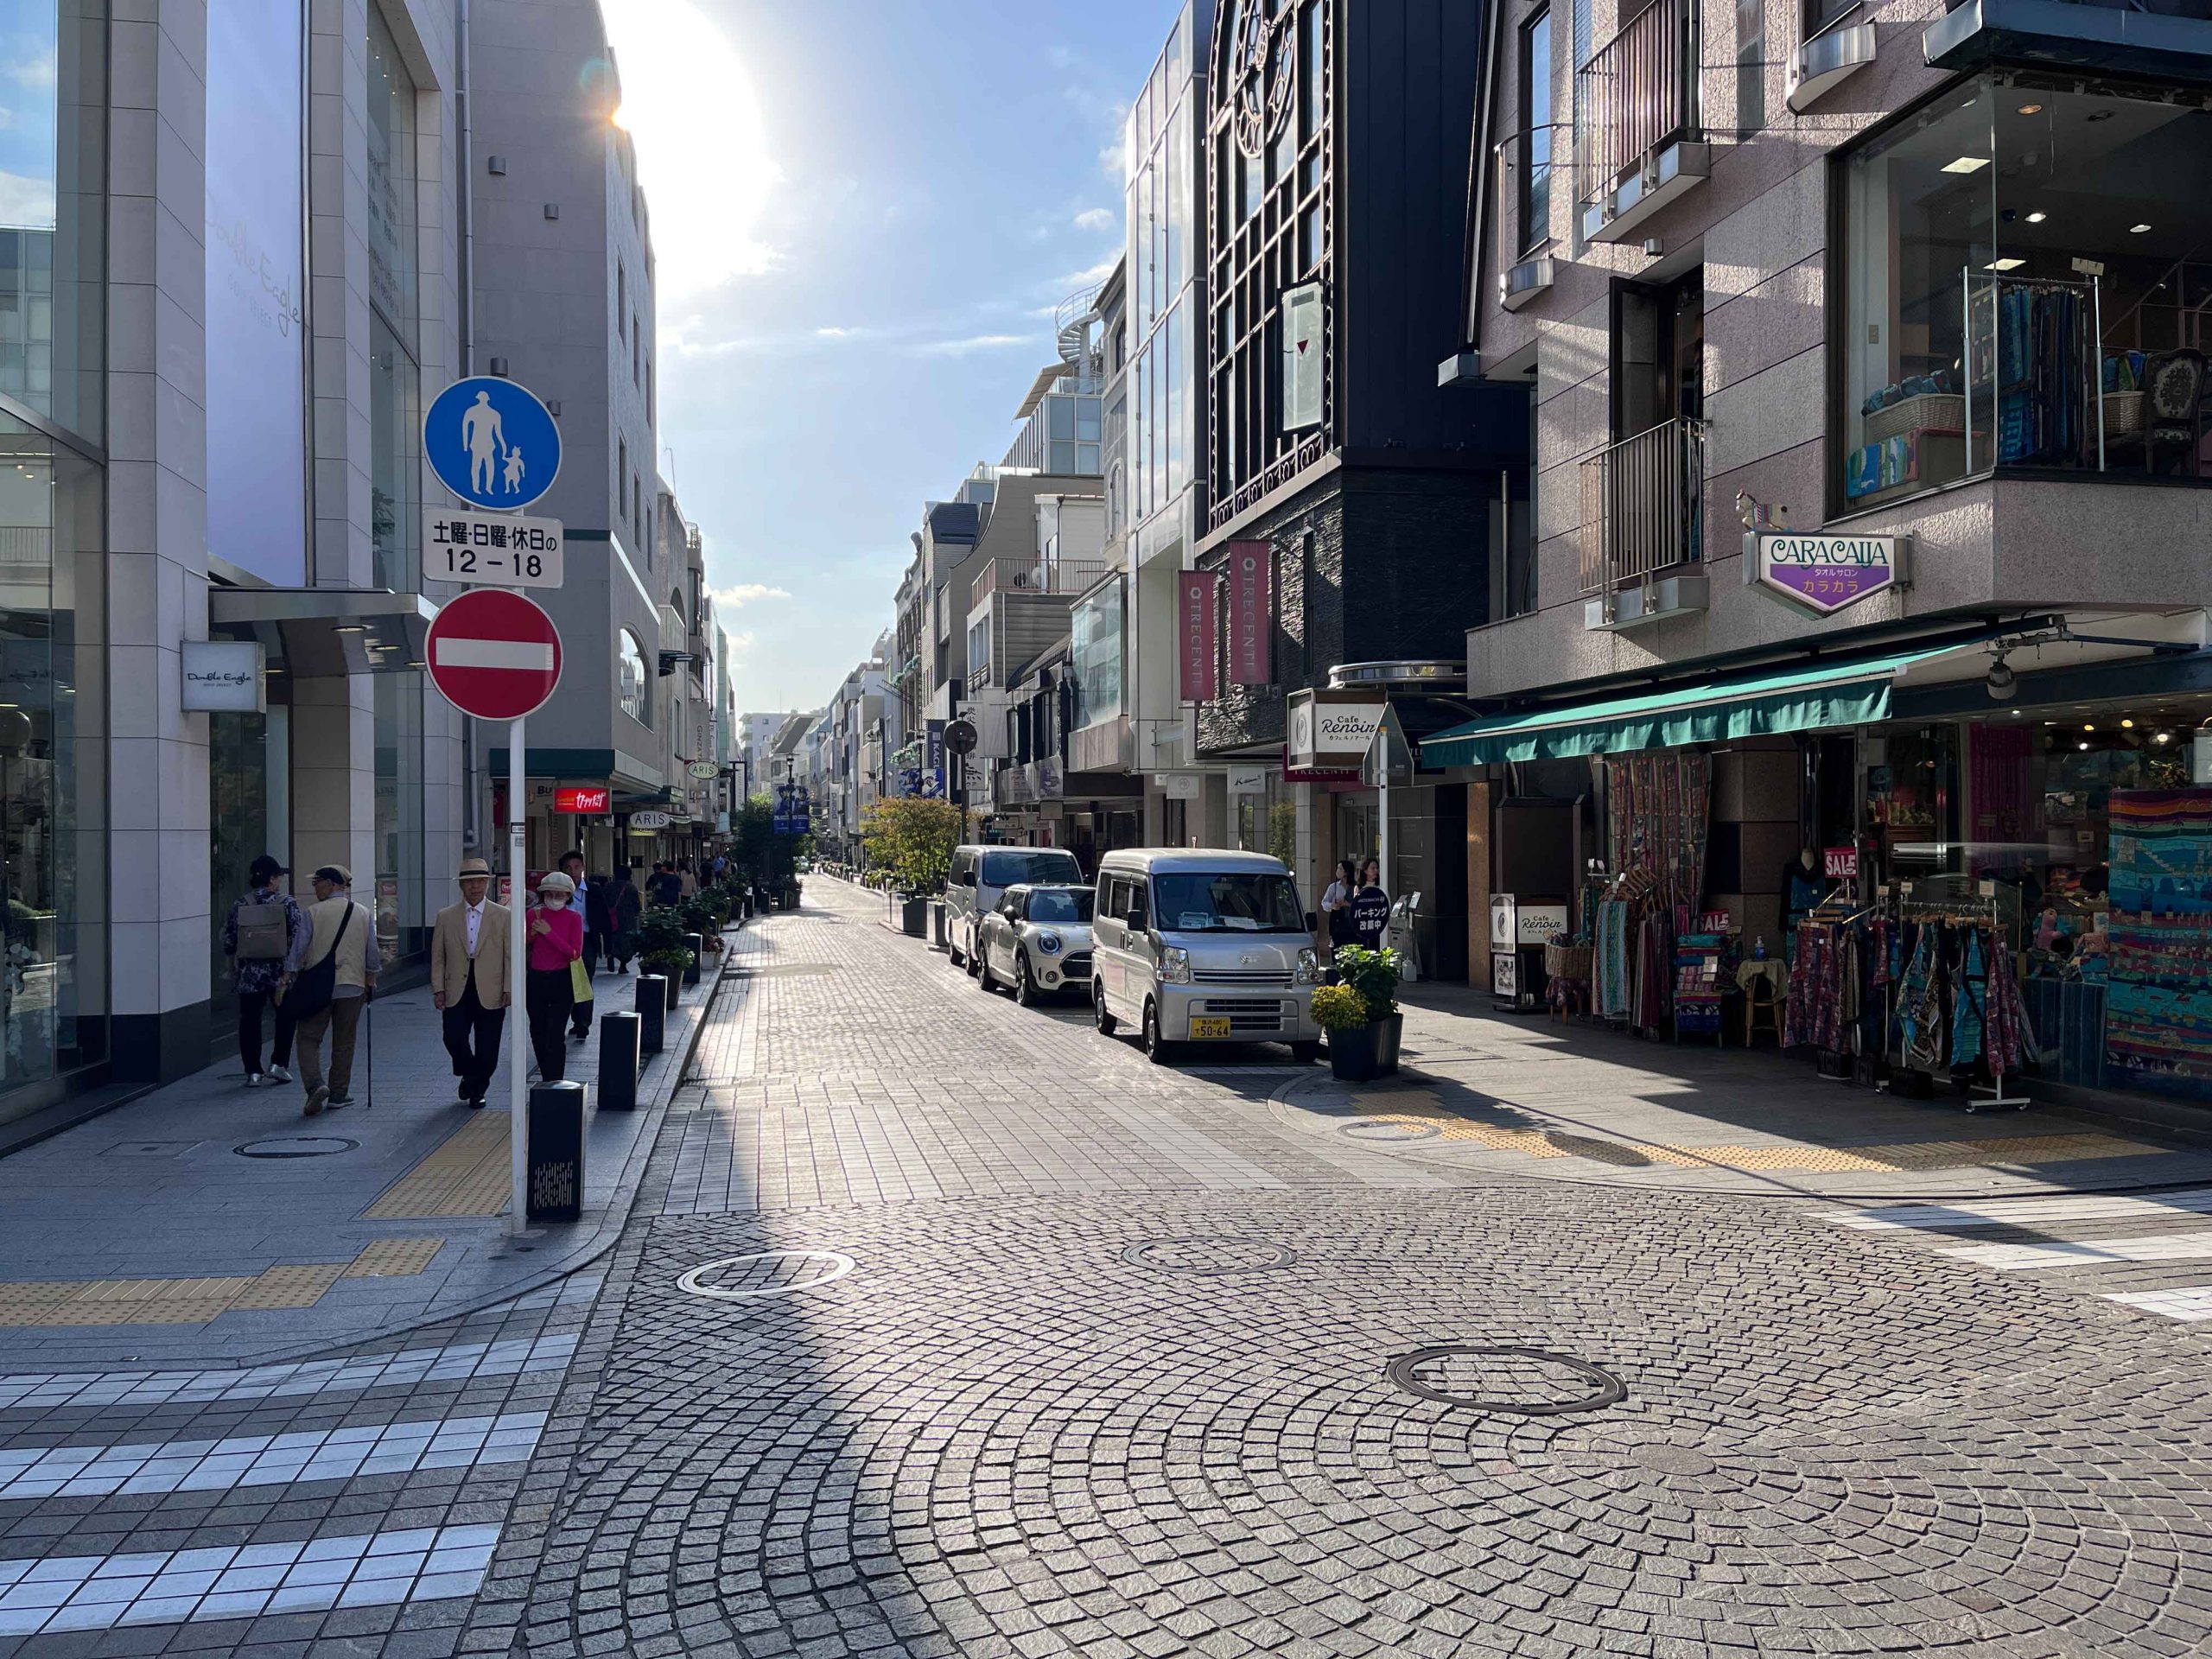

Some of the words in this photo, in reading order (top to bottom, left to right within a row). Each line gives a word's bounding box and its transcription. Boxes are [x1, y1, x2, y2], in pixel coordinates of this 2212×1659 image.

[1814, 568, 1859, 578] タオルサロン
[1802, 580, 1859, 594] カラカラ
[1242, 575, 1257, 670] TRECENTI
[1191, 601, 1205, 685] TRECENTI
[223, 671, 252, 685] Eagle
[1321, 719, 1376, 733] Renoir
[692, 766, 714, 775] ARIS
[635, 814, 664, 824] ARIS
[1826, 855, 1857, 875] SALE
[1354, 907, 1388, 918] パーキング
[1522, 918, 1563, 929] Renoir
[1700, 913, 1729, 931] SALE
[1200, 1026, 1229, 1036] 50-64
